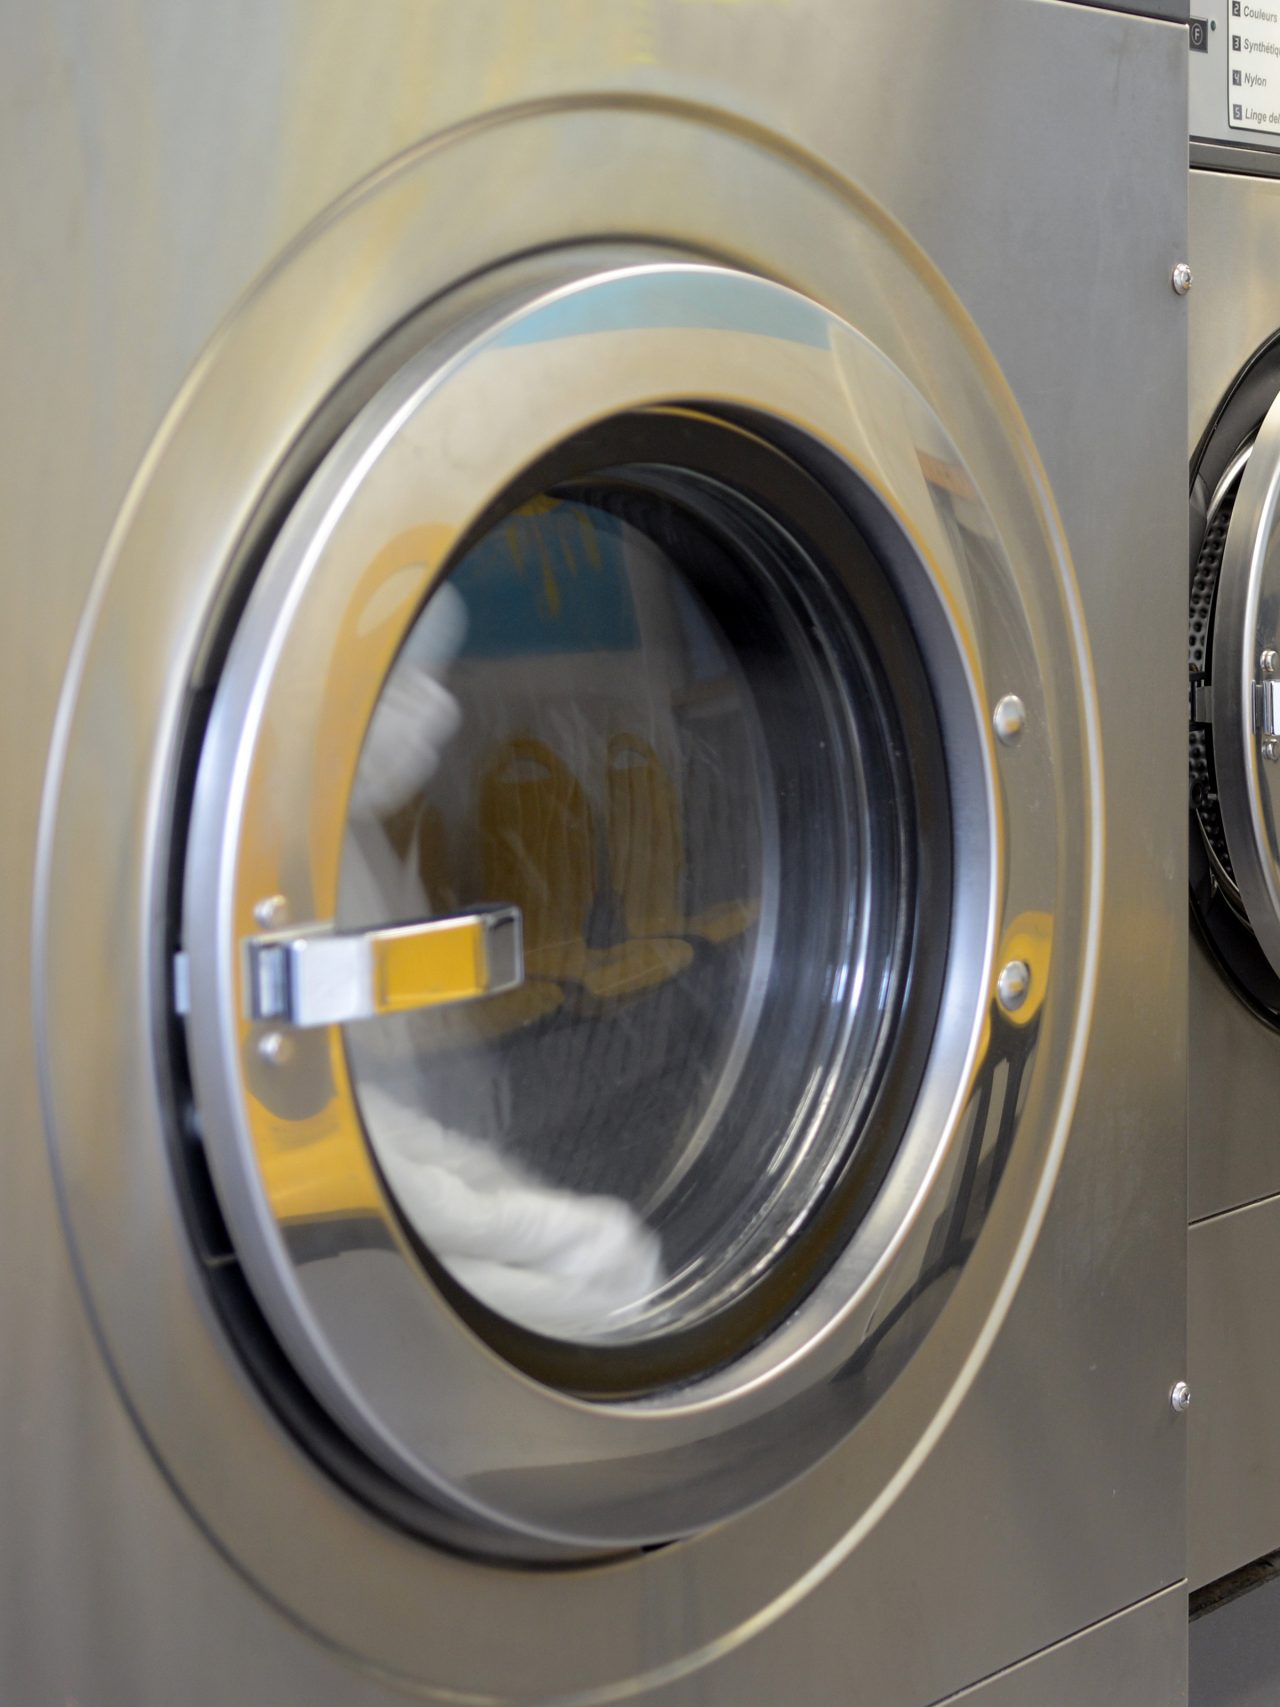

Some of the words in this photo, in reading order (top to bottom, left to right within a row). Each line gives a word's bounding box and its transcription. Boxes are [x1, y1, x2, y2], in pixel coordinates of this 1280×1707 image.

[1243, 6, 1278, 22] Couleurs
[1244, 73, 1267, 87] Nylon
[1245, 108, 1267, 124] Linge
